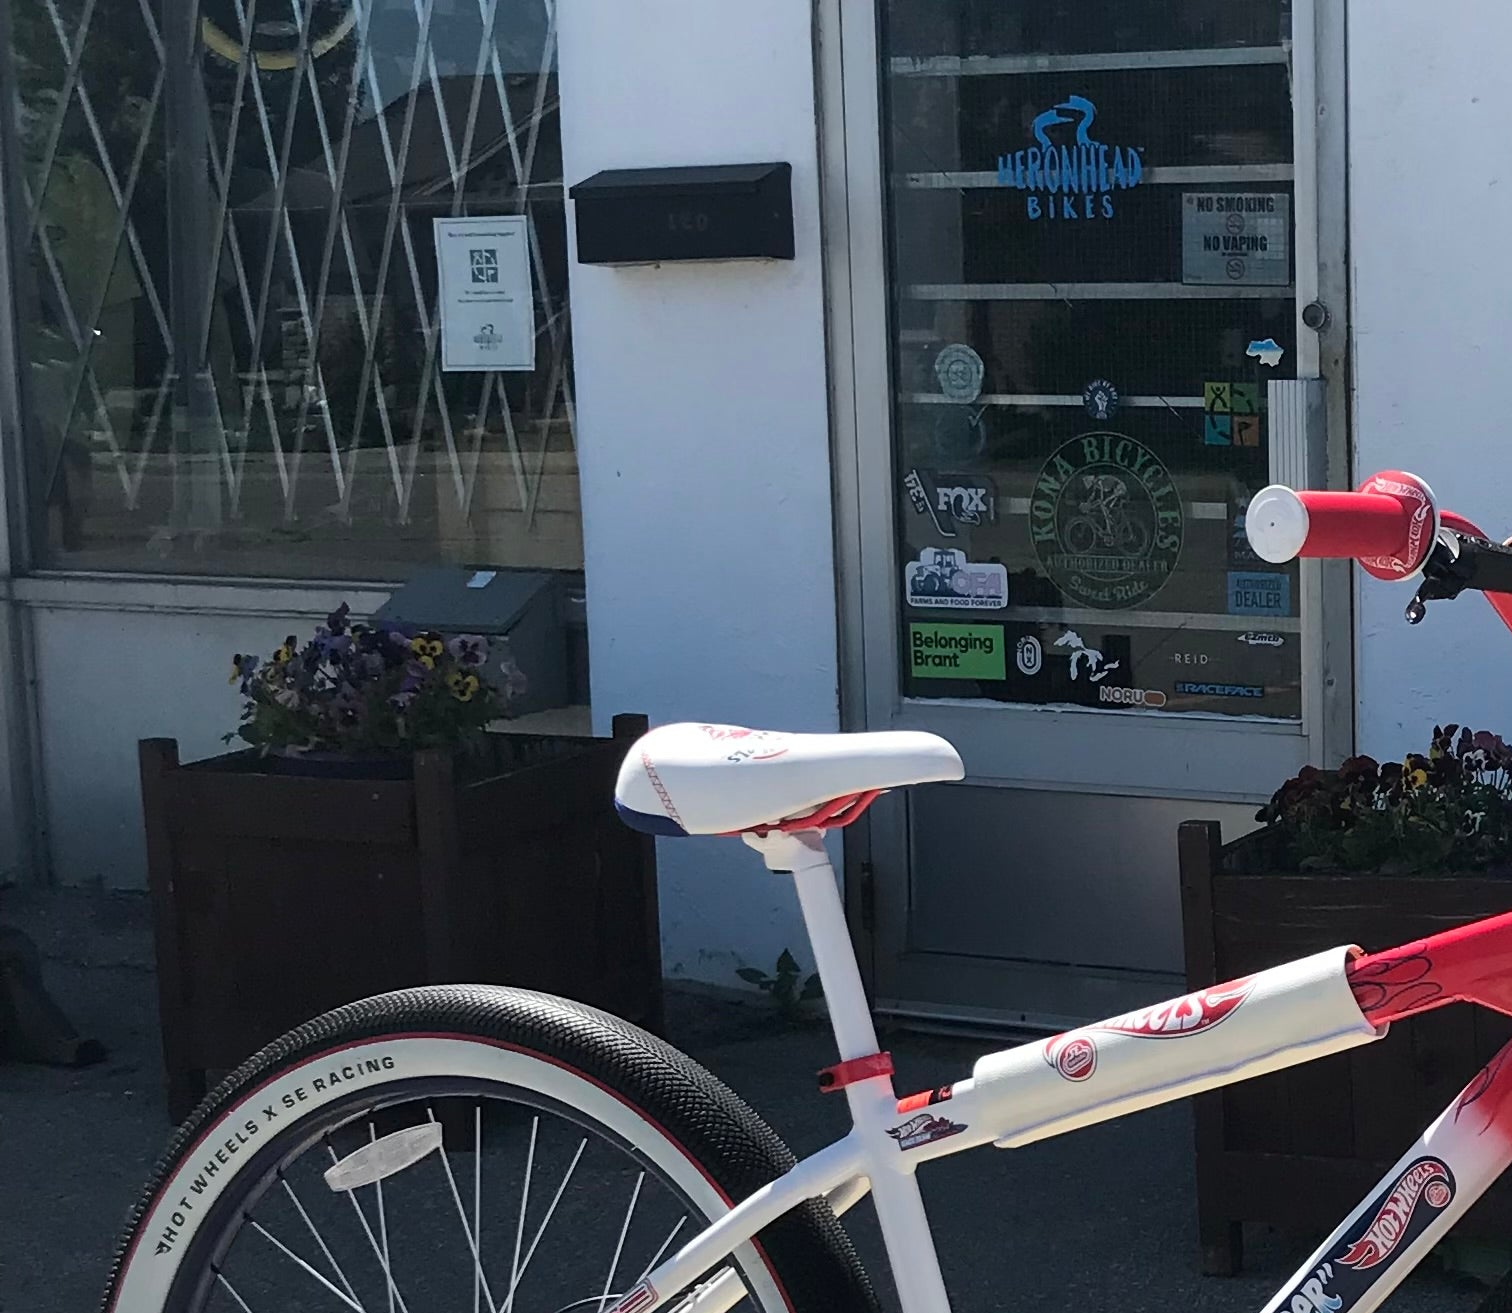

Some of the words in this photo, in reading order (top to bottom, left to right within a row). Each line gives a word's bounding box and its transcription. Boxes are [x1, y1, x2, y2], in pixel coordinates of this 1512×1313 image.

[997, 145, 1142, 195] HERONHEAD
[1027, 194, 1114, 220] BIKES
[1197, 196, 1213, 213] NO
[1216, 196, 1275, 213] SMOKING
[1203, 235, 1220, 252] NO
[1222, 235, 1268, 252] VAPING
[937, 487, 987, 513] FOX
[1032, 453, 1076, 543] KONA
[1081, 435, 1181, 552] BICYCLES
[1112, 579, 1149, 602] Ride
[1235, 591, 1281, 608] DEALER
[912, 631, 994, 655] Belonging
[914, 650, 960, 668] Brant
[1174, 653, 1209, 664] REID
[1100, 686, 1143, 703] NORU
[1184, 683, 1264, 697] RACEFACE
[162, 1197, 194, 1244] HOT
[189, 1120, 259, 1195] WHEELS
[262, 1105, 278, 1121] X
[281, 1088, 308, 1108] SE
[311, 1055, 396, 1093] RACING
